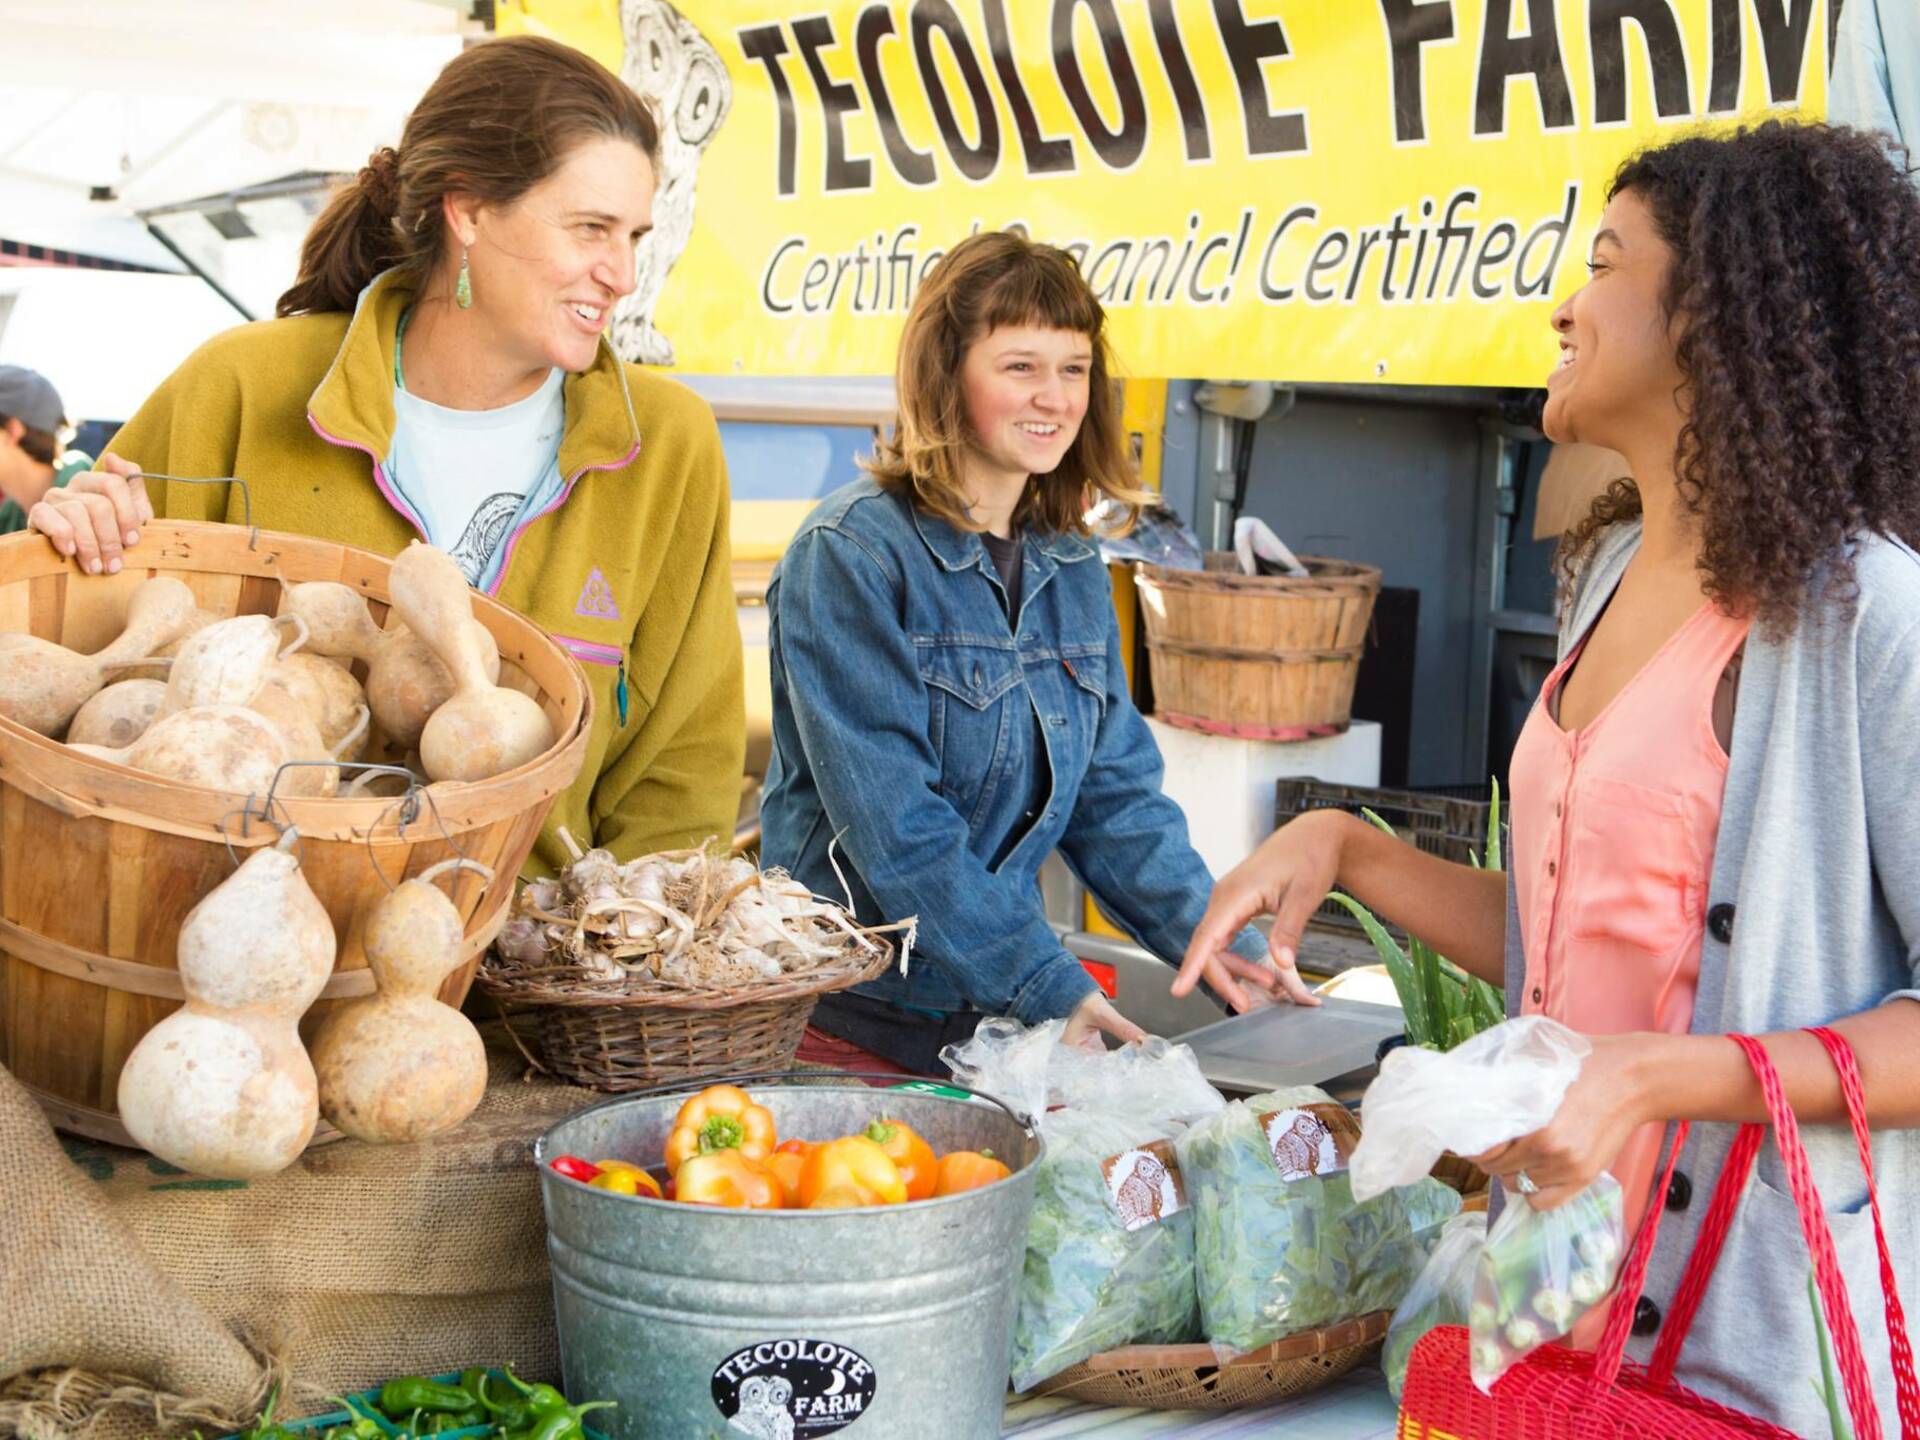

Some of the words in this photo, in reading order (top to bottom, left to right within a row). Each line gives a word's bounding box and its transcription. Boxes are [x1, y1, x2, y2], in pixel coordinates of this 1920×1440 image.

[739, 0, 1307, 194] TECOLOTE
[763, 222, 979, 312] Certifi
[1259, 185, 1578, 301] Certified
[715, 1339, 873, 1385] TECOLOTE
[794, 1392, 863, 1416] FARM
